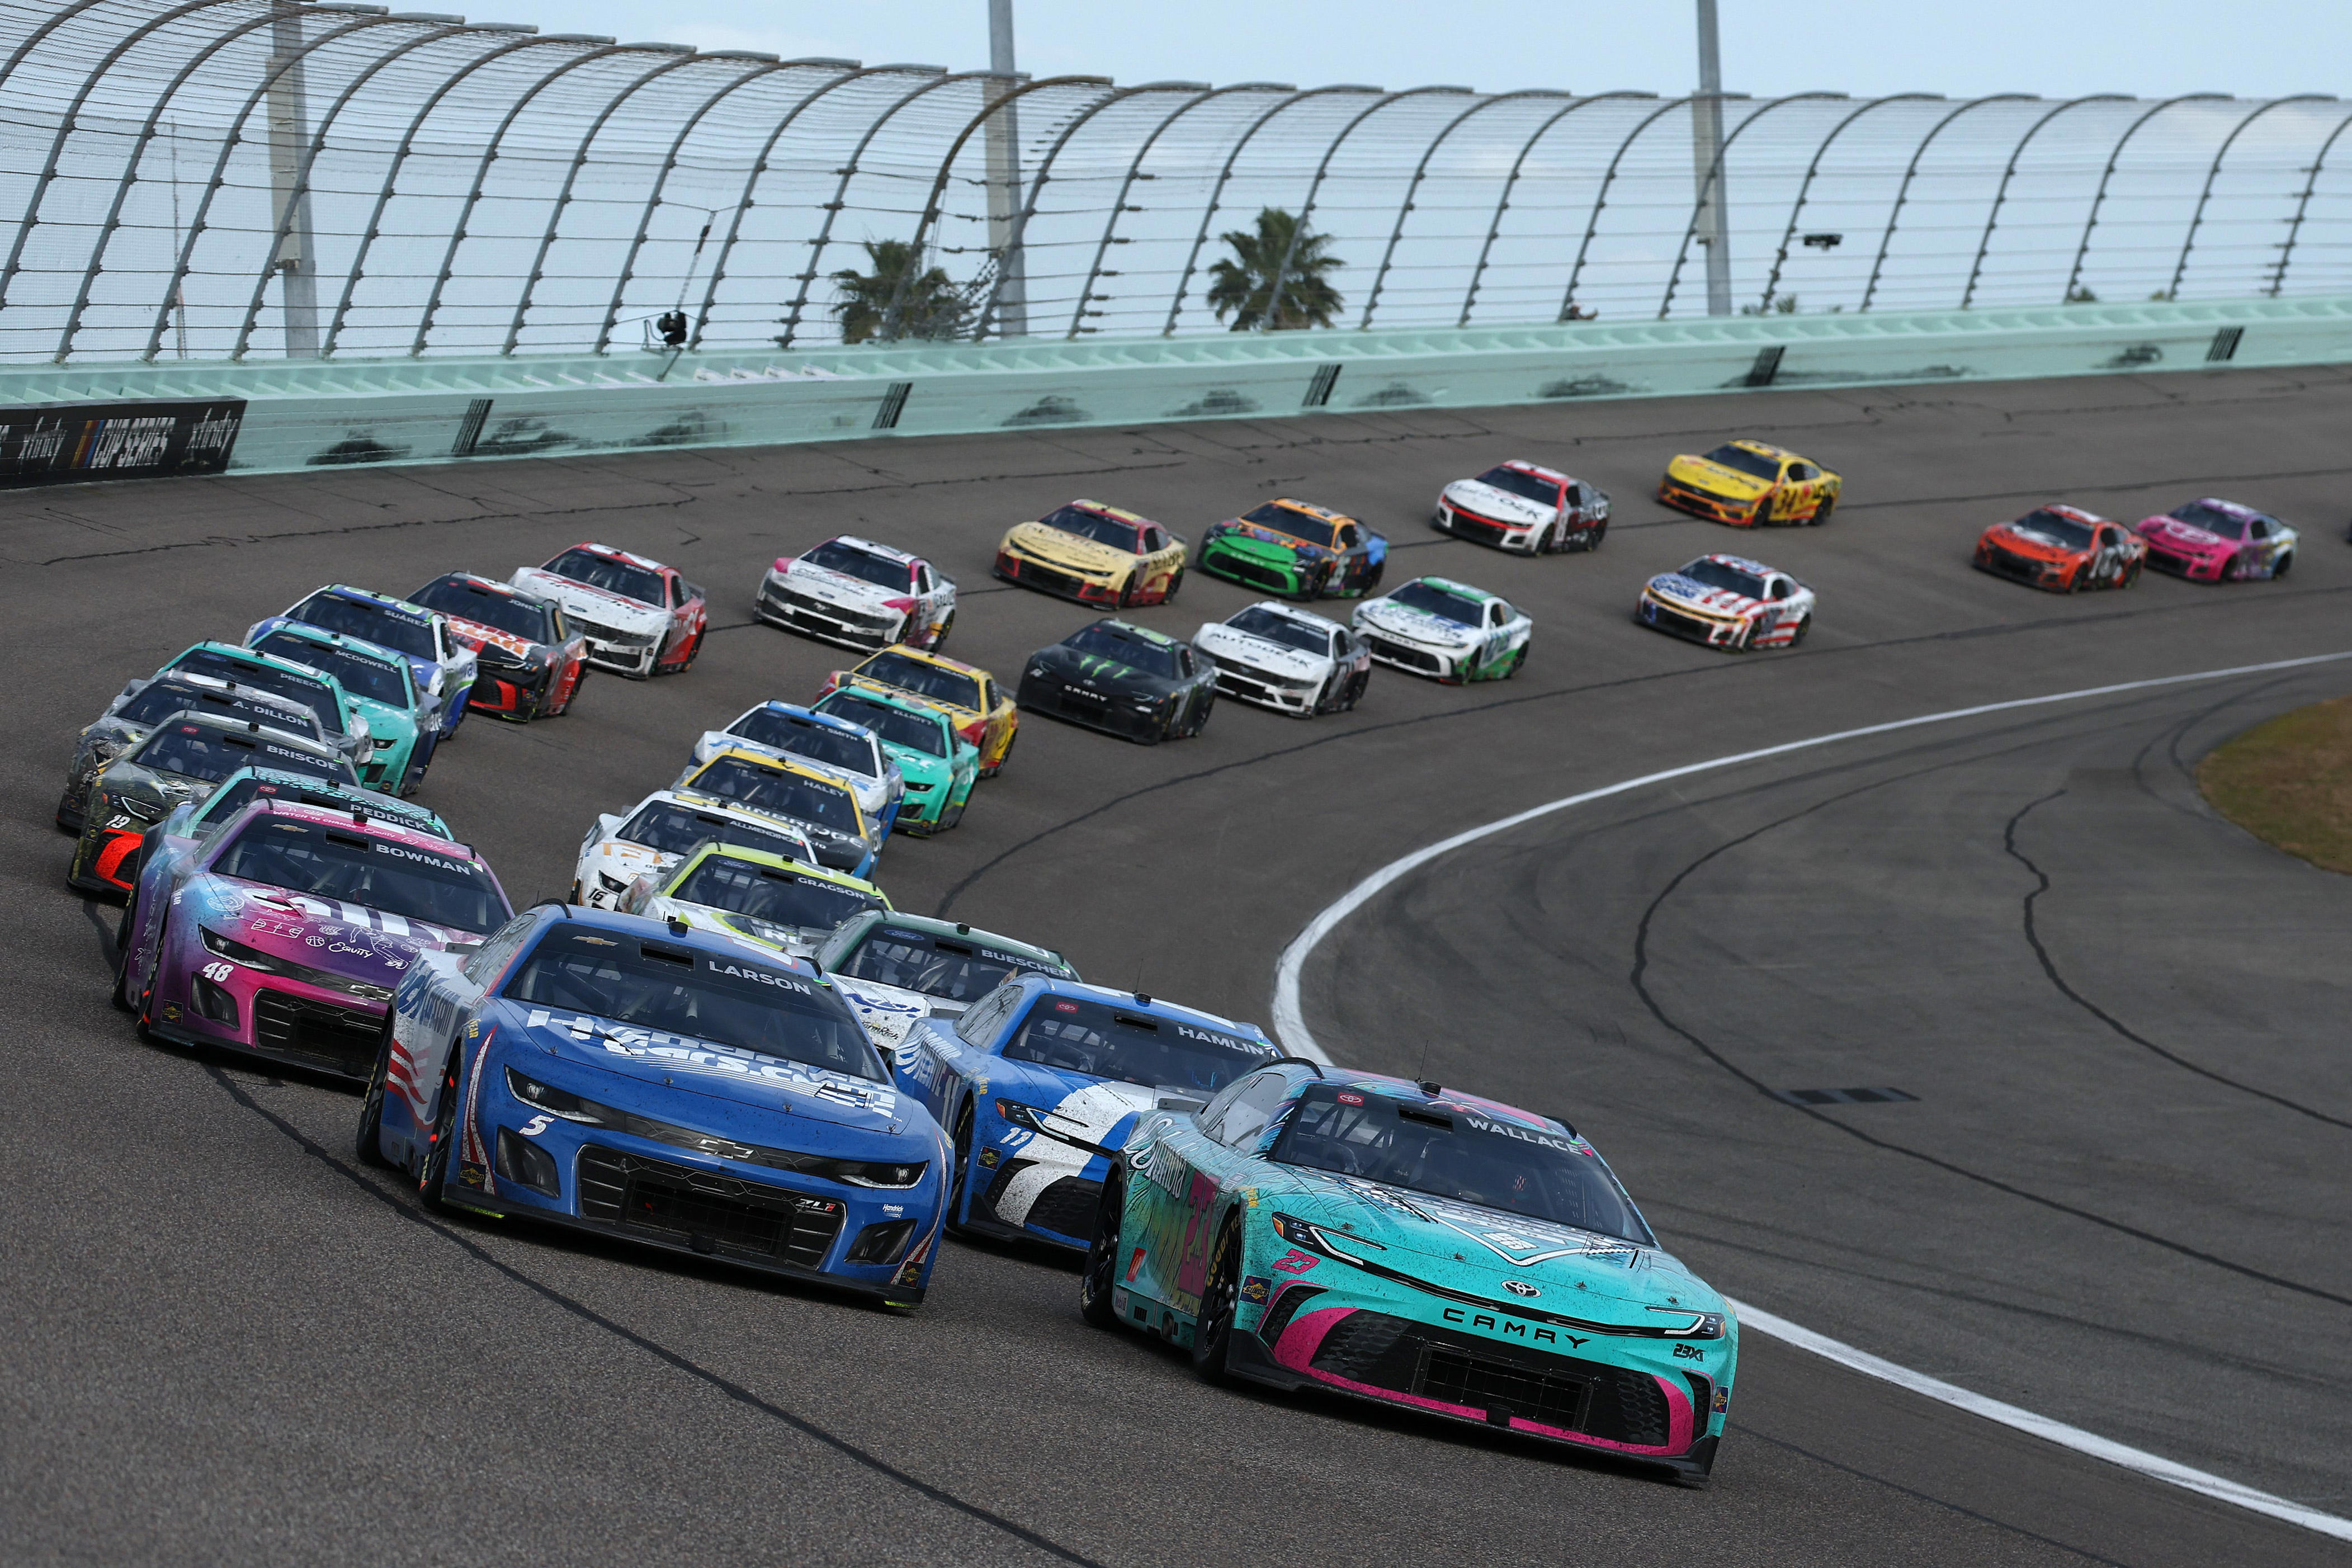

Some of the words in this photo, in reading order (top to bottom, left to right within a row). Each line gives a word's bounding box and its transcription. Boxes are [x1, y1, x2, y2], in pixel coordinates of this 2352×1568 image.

[116, 417, 176, 468] SERIES
[507, 598, 541, 613] JONES
[280, 673, 324, 691] PREECE
[232, 700, 249, 710] A.
[254, 705, 308, 727] DILLON
[828, 730, 858, 742] SMITH
[266, 744, 339, 771] BRISCOE
[803, 780, 845, 797] HALEY
[375, 843, 471, 876] BOWMAN
[587, 888, 608, 901] 16
[797, 877, 866, 900] GRAGSON
[202, 960, 234, 983] 48
[981, 949, 1071, 979] BUESCHER
[708, 960, 812, 996] LARSON
[1177, 1026, 1267, 1056] HAMLIN
[518, 1114, 556, 1136] 5
[999, 1127, 1033, 1146] 11
[1466, 1117, 1583, 1155] WALLACE
[1271, 1248, 1321, 1275] 23
[1443, 1306, 1591, 1349] CAMRY
